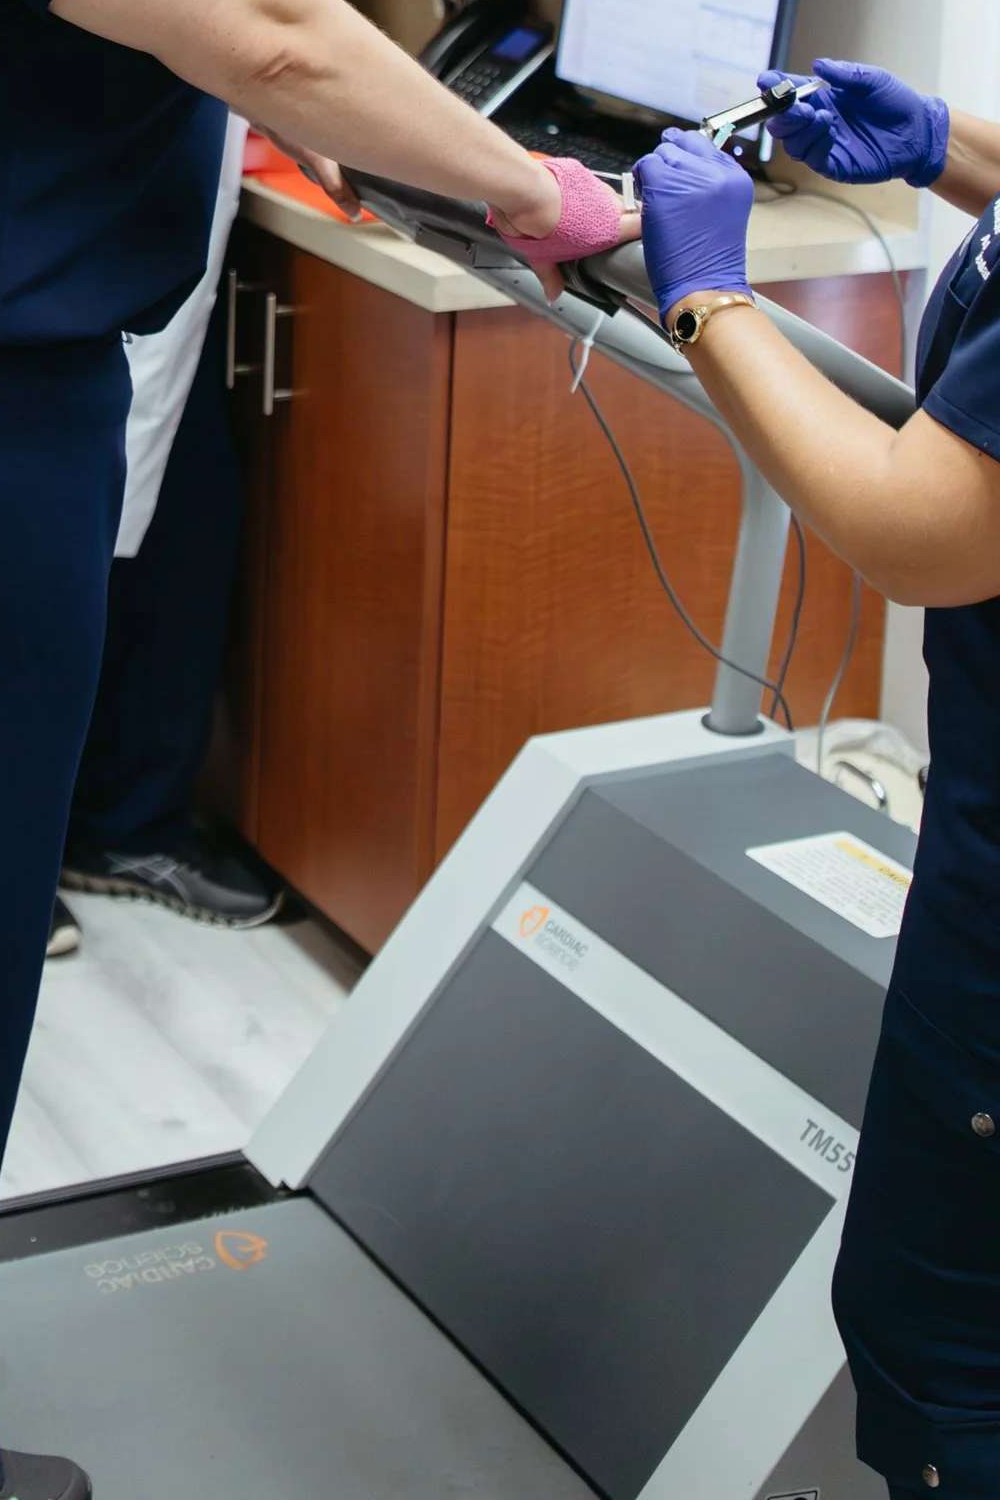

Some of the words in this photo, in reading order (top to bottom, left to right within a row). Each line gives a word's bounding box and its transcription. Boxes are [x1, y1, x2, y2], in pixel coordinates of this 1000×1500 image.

[544, 919, 589, 958] CARDIAC
[800, 1118, 855, 1173] TM55
[97, 1256, 216, 1294] CARDIAC
